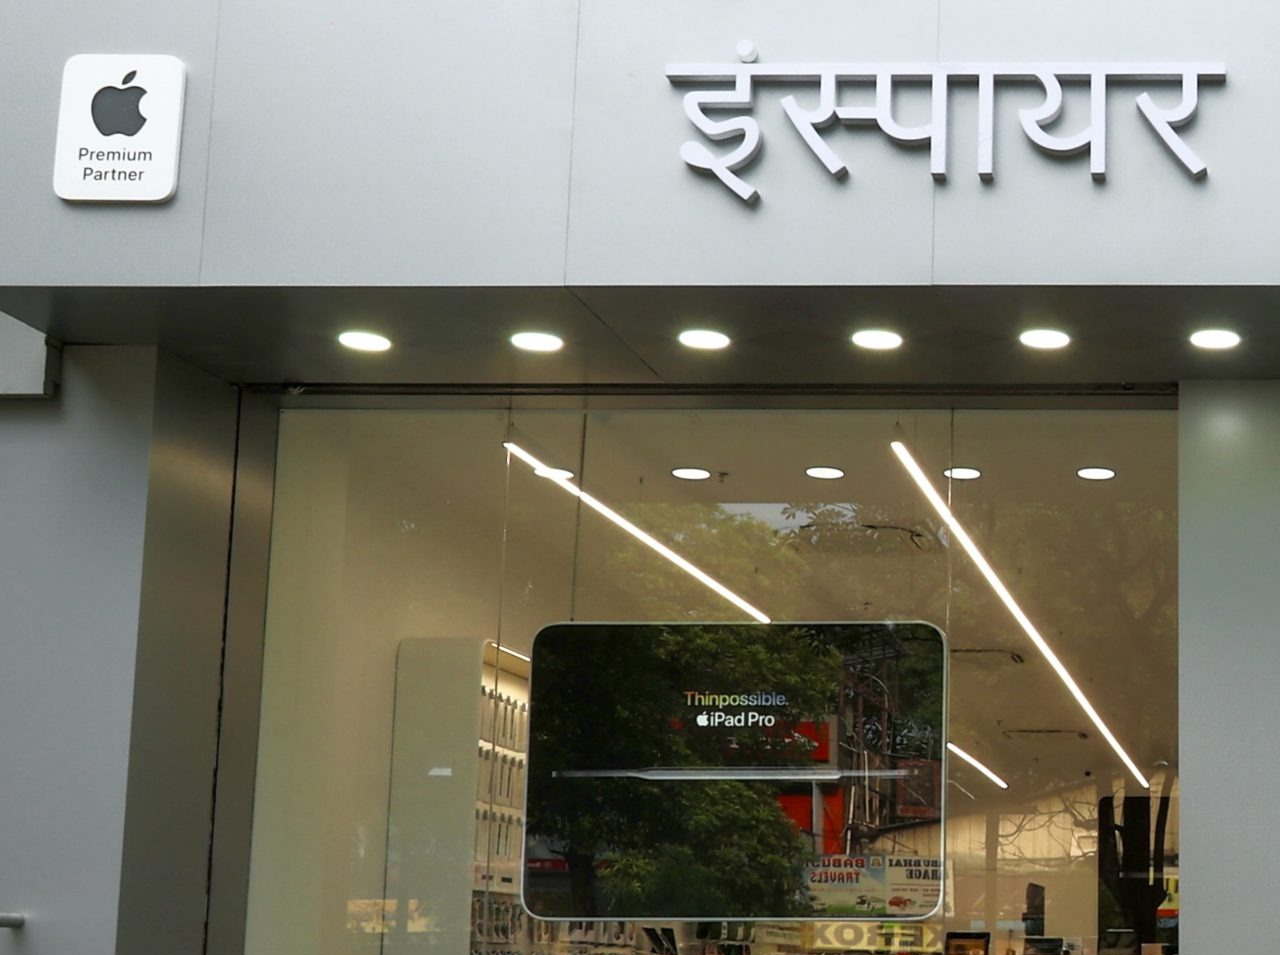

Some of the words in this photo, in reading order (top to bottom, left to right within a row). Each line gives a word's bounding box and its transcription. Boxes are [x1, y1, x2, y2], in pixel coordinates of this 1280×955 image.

[665, 39, 1227, 201] इंस्पायर
[78, 147, 152, 161] Premium
[83, 167, 144, 181] Partner
[683, 691, 789, 709] Thinpossible.
[710, 711, 745, 727] iPad
[748, 711, 775, 727] Pro
